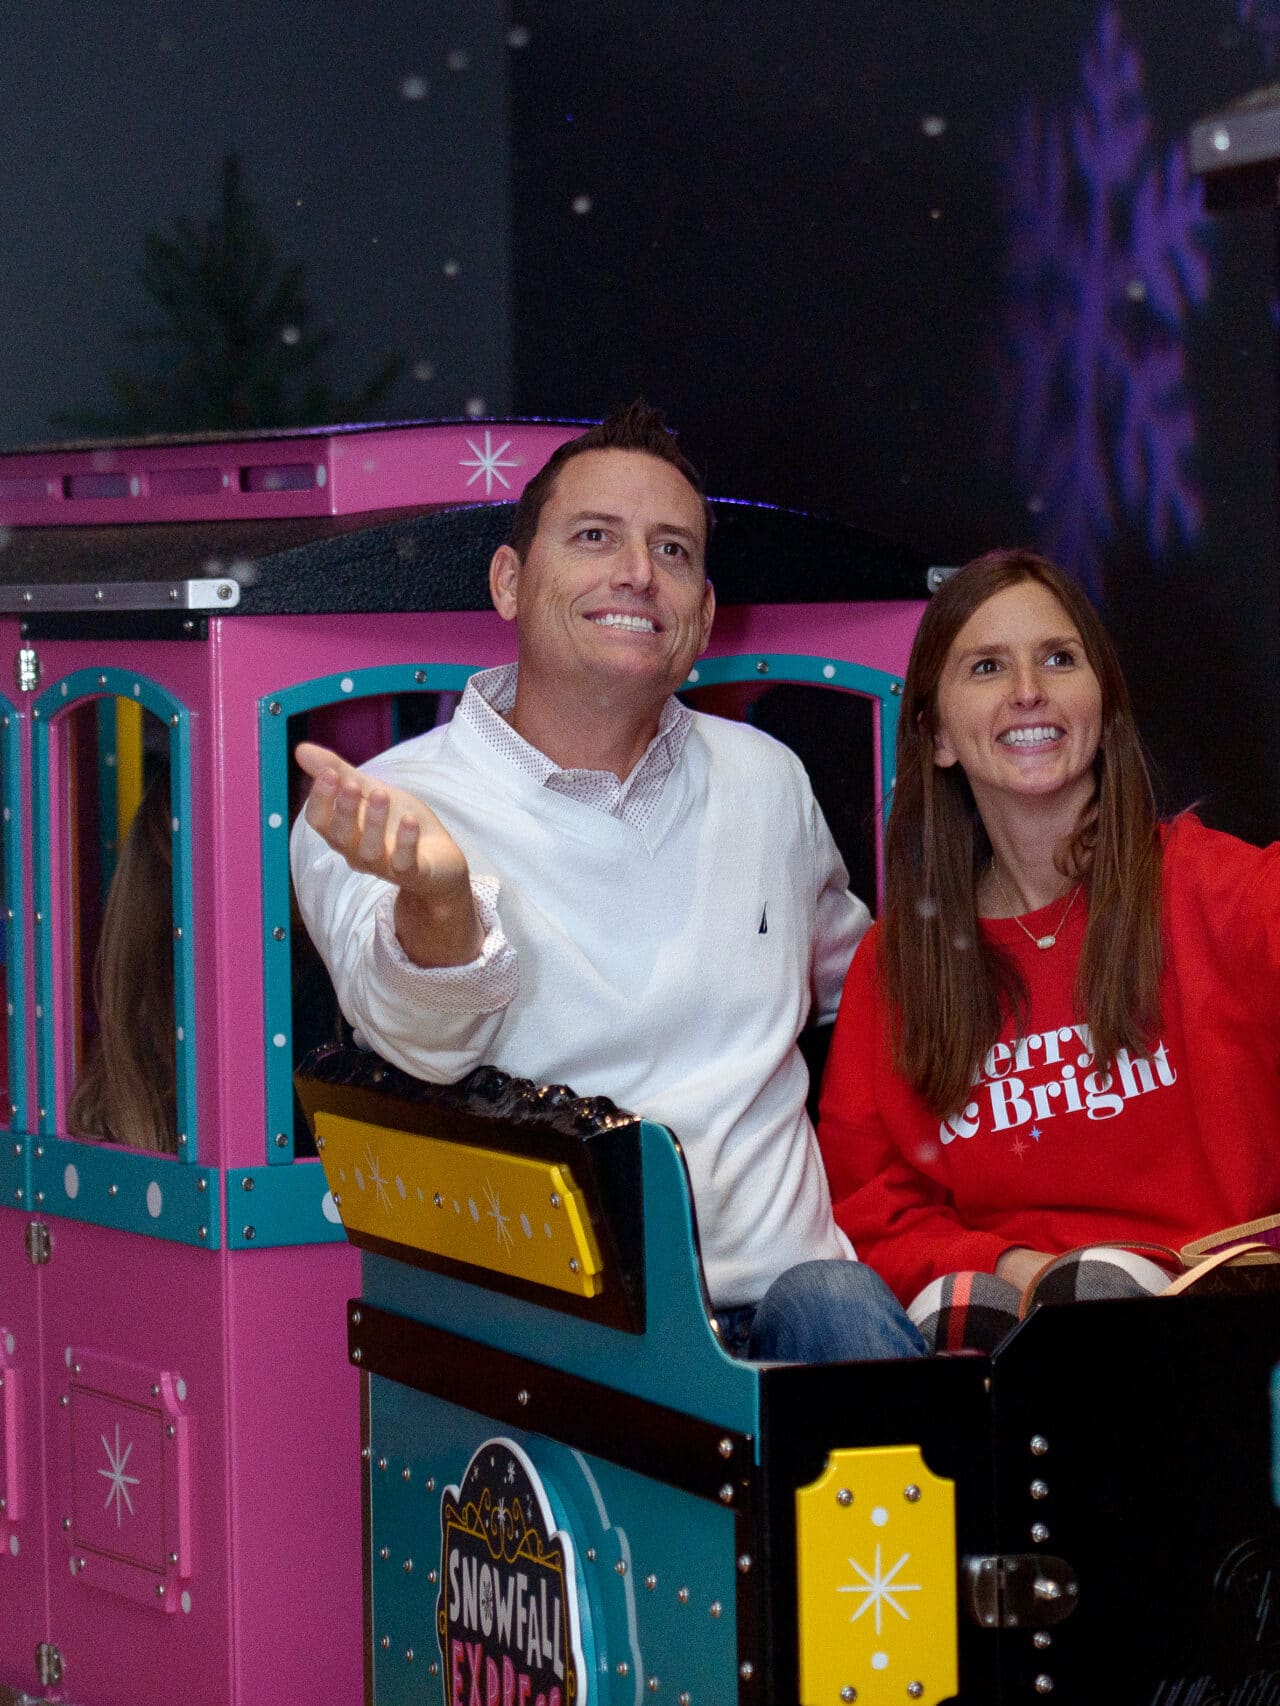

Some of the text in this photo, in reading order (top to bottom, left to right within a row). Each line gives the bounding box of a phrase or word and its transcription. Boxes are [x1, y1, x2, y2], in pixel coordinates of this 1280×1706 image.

[939, 1039, 1178, 1145] & Bright
[970, 1023, 1095, 1086] erry
[449, 1548, 565, 1681] SNOWFALL
